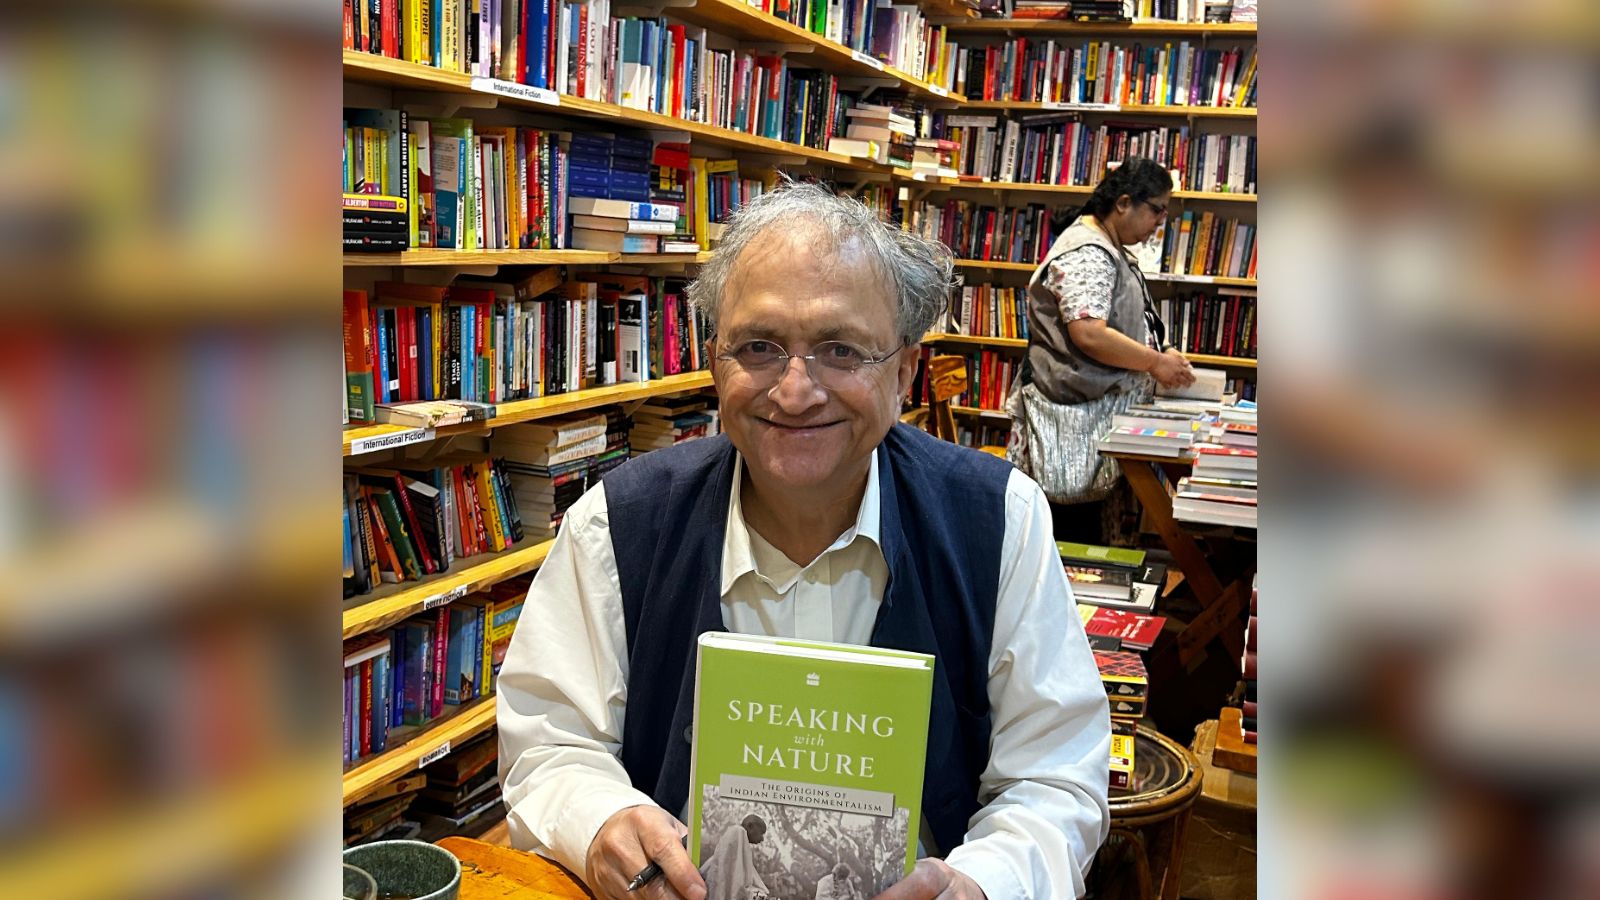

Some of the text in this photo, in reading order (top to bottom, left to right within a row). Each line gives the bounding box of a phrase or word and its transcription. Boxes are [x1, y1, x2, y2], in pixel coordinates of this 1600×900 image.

[579, 20, 587, 81] PACHINKO
[493, 82, 541, 99] International Fiction
[363, 431, 426, 450] International Fiction
[728, 700, 894, 738] SPEAKING
[794, 733, 825, 747] with
[742, 744, 875, 778] NATURE
[730, 787, 883, 812] INDIAN ENVIRONMENTALISM
[761, 782, 847, 799] THE ORIGINS OF
